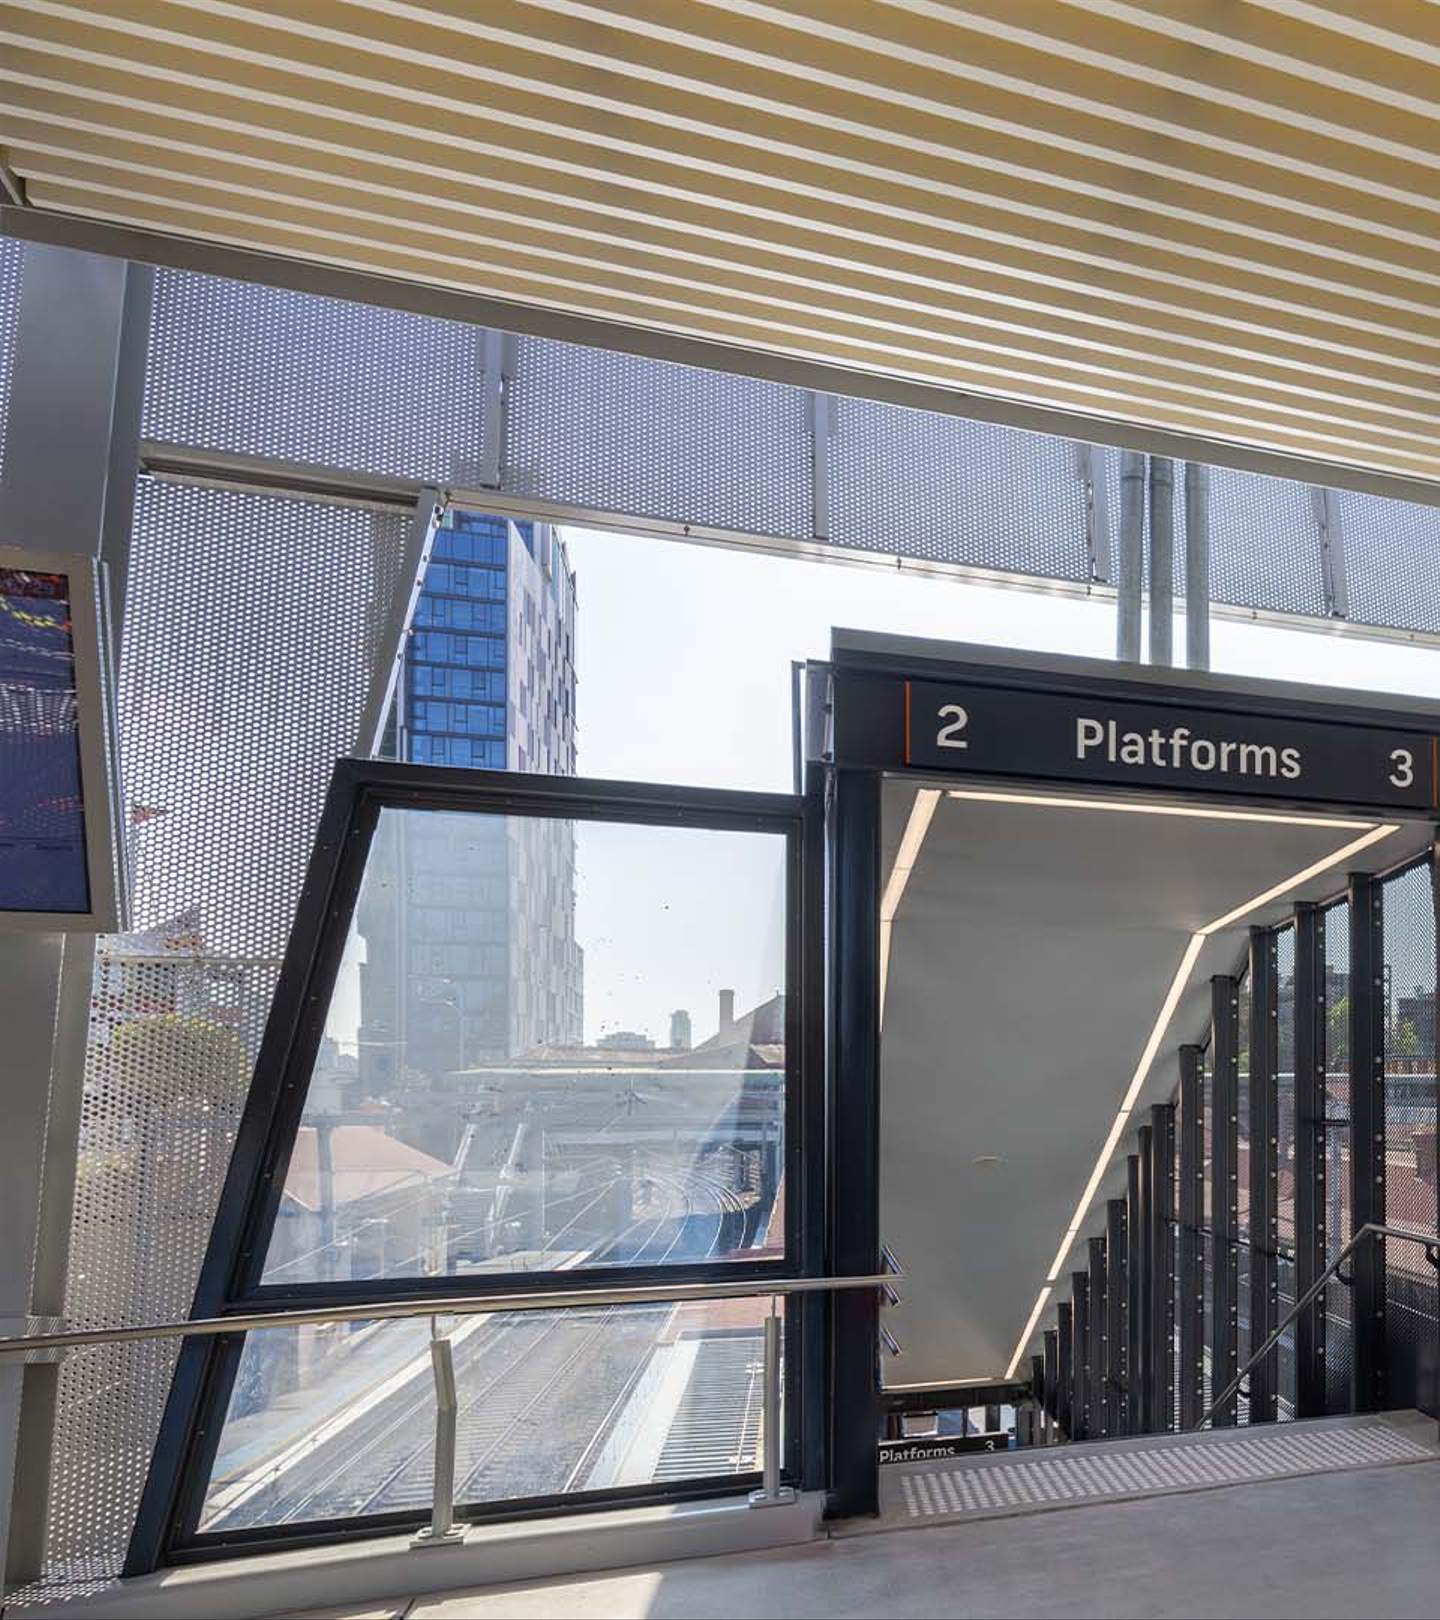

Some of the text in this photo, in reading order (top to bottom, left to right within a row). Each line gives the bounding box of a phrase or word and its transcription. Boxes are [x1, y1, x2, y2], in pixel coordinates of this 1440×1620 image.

[936, 704, 1414, 788] 2 Platforms 3
[879, 1440, 995, 1462] Platforms 3
